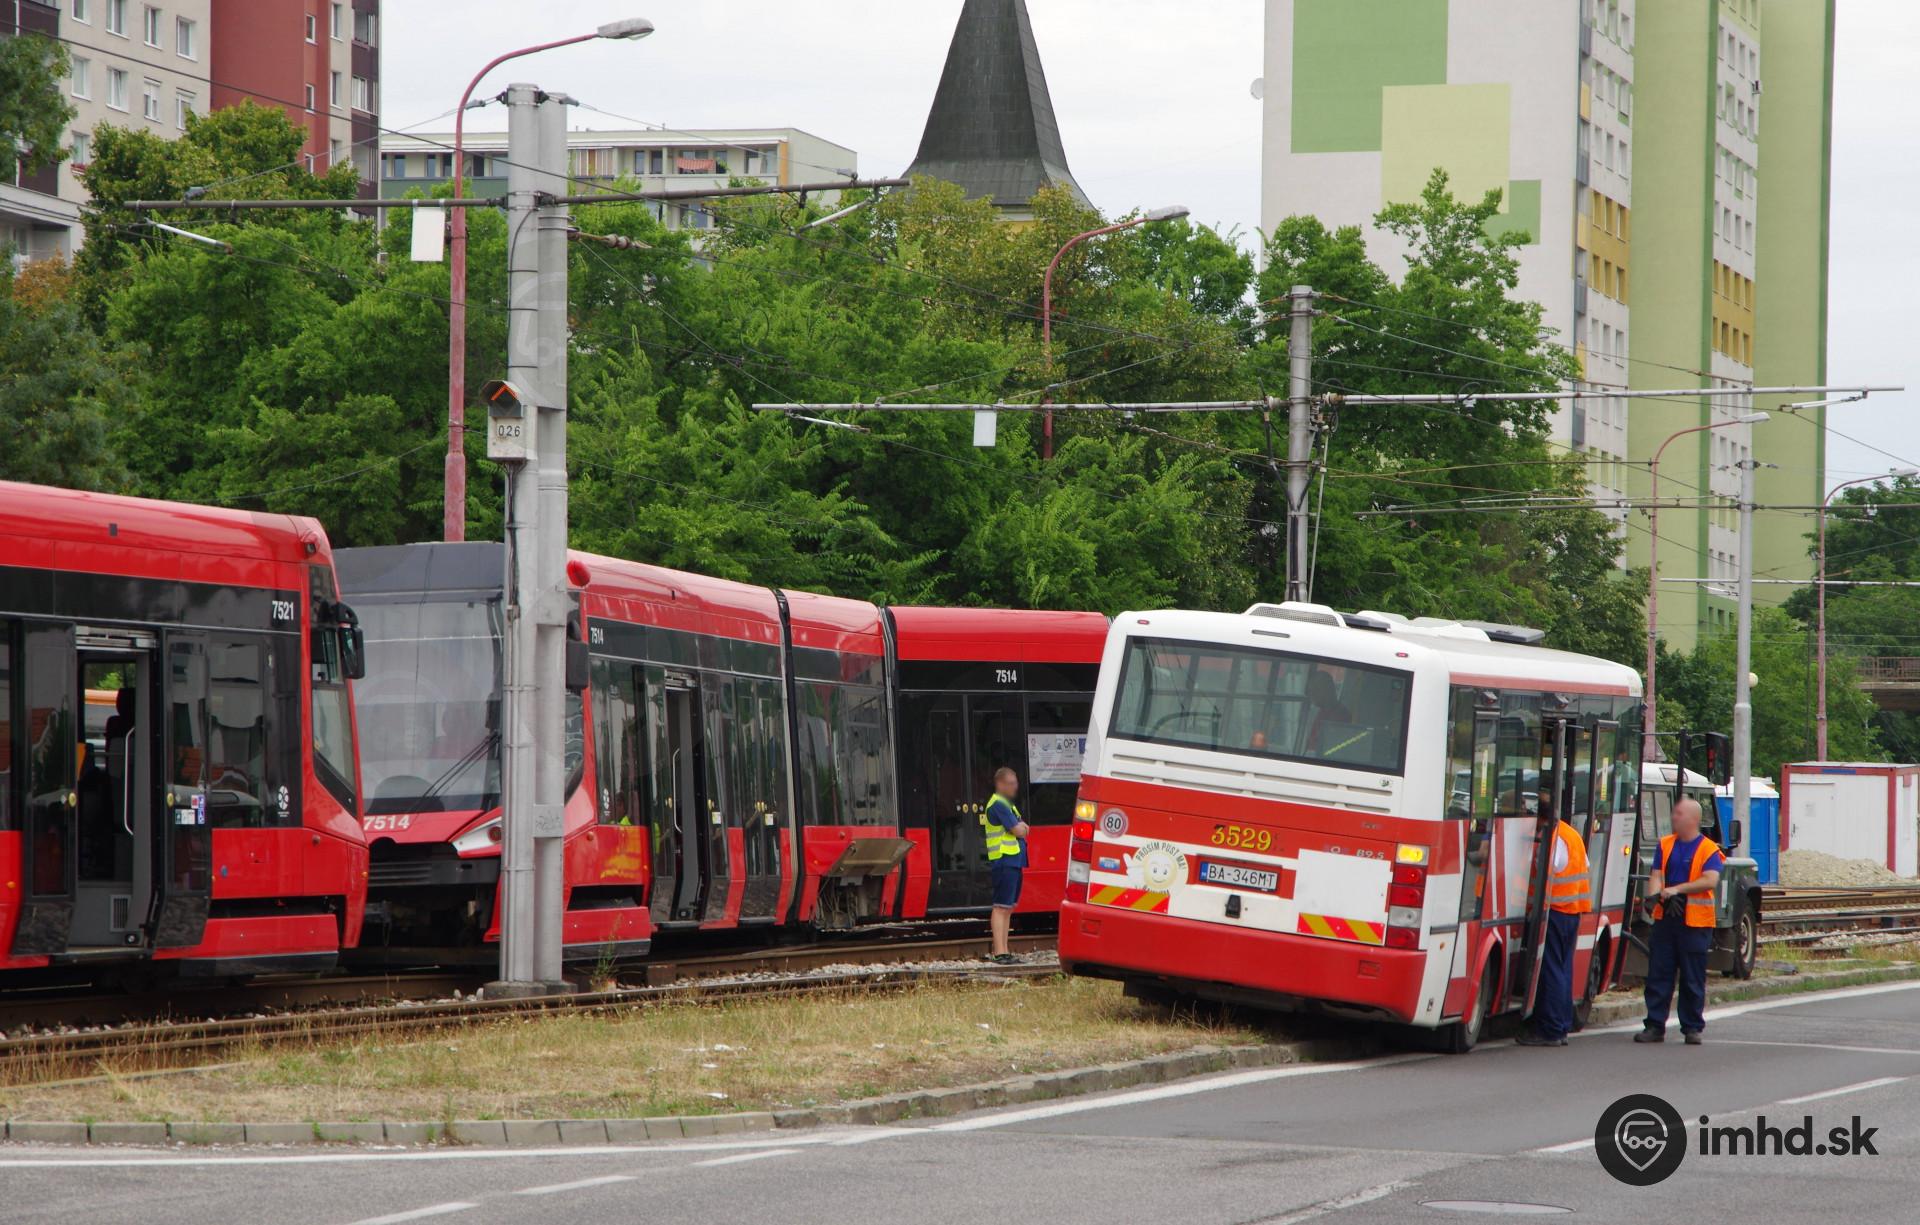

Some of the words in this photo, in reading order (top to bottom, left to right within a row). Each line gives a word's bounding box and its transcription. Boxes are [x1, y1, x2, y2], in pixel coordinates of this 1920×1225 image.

[498, 424, 521, 437] 026
[271, 600, 294, 620] 7521
[590, 626, 604, 645] 7514
[995, 669, 1017, 683] 7514
[363, 815, 410, 830] 7514
[1106, 816, 1121, 830] 80
[1211, 824, 1272, 851] 3529
[1208, 865, 1275, 887] BA-346MT
